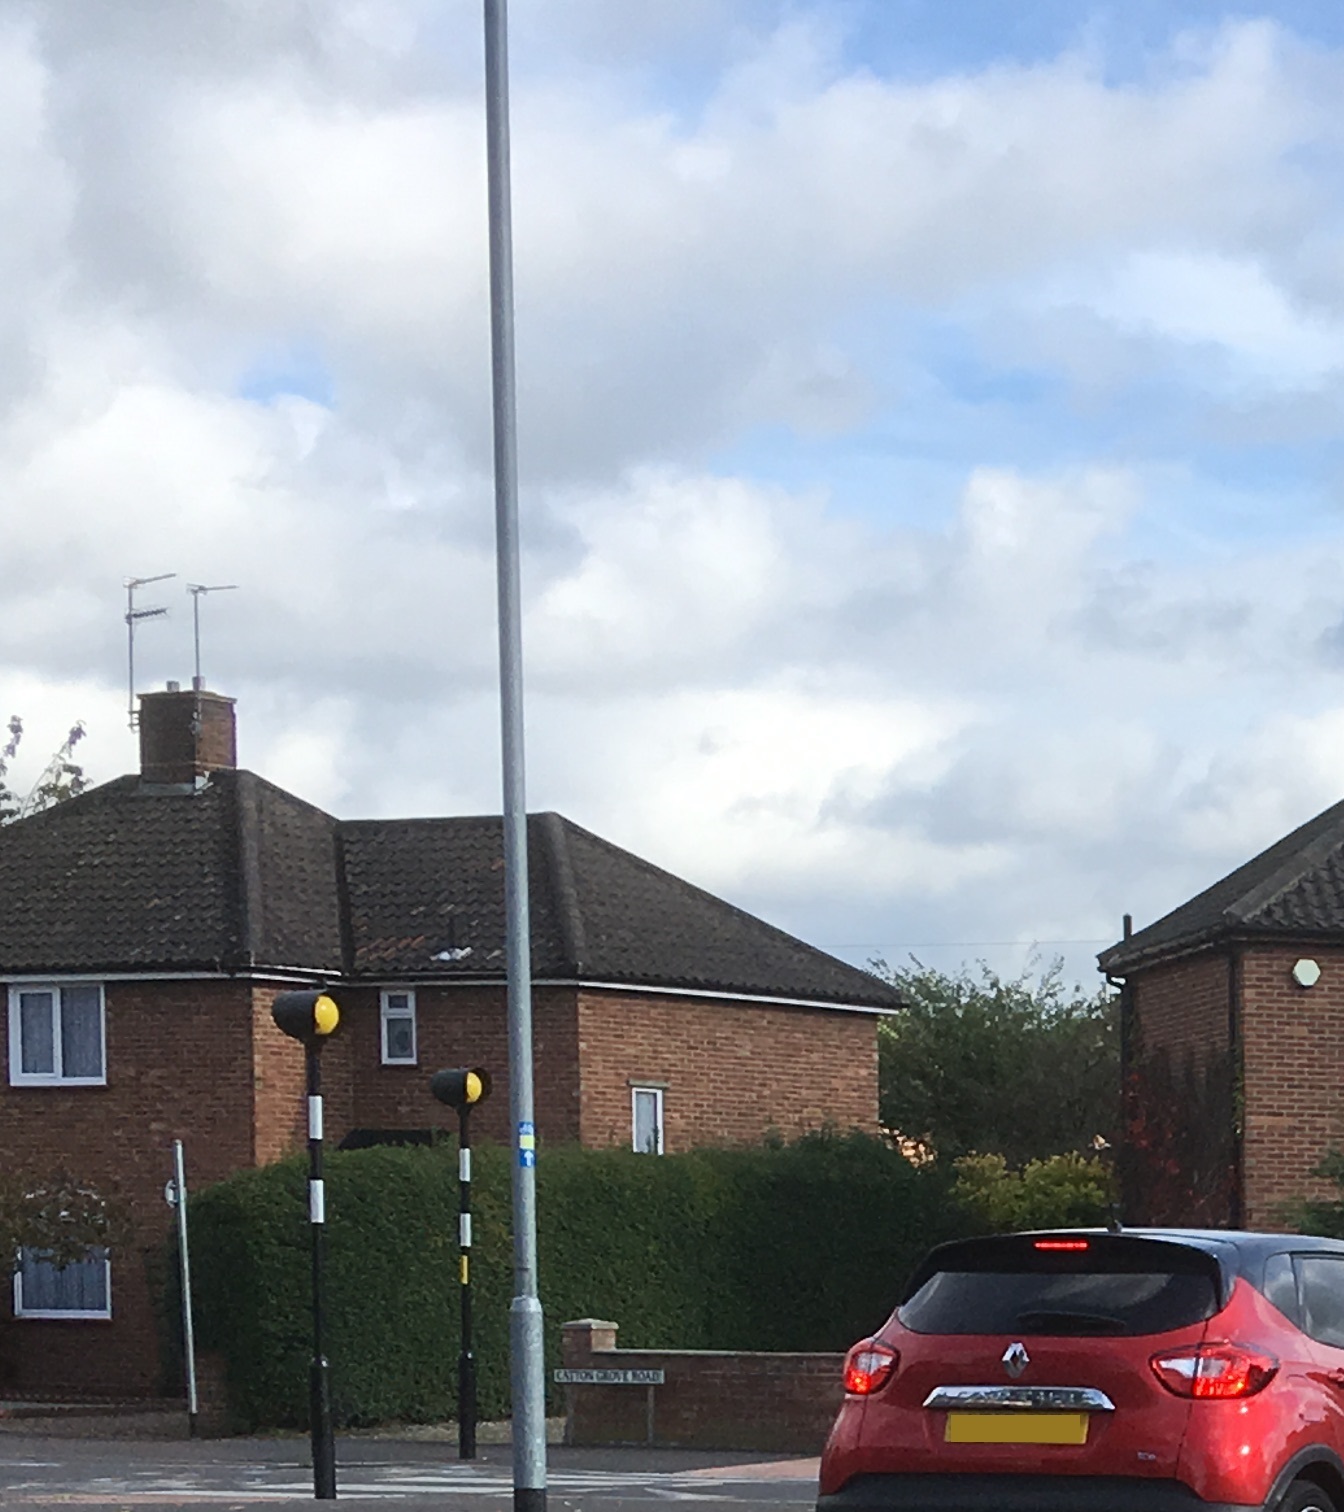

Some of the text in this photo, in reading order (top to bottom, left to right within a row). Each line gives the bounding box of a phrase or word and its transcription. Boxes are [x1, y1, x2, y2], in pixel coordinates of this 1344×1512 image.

[556, 1370, 661, 1383] CATTON GROVE ROAD
